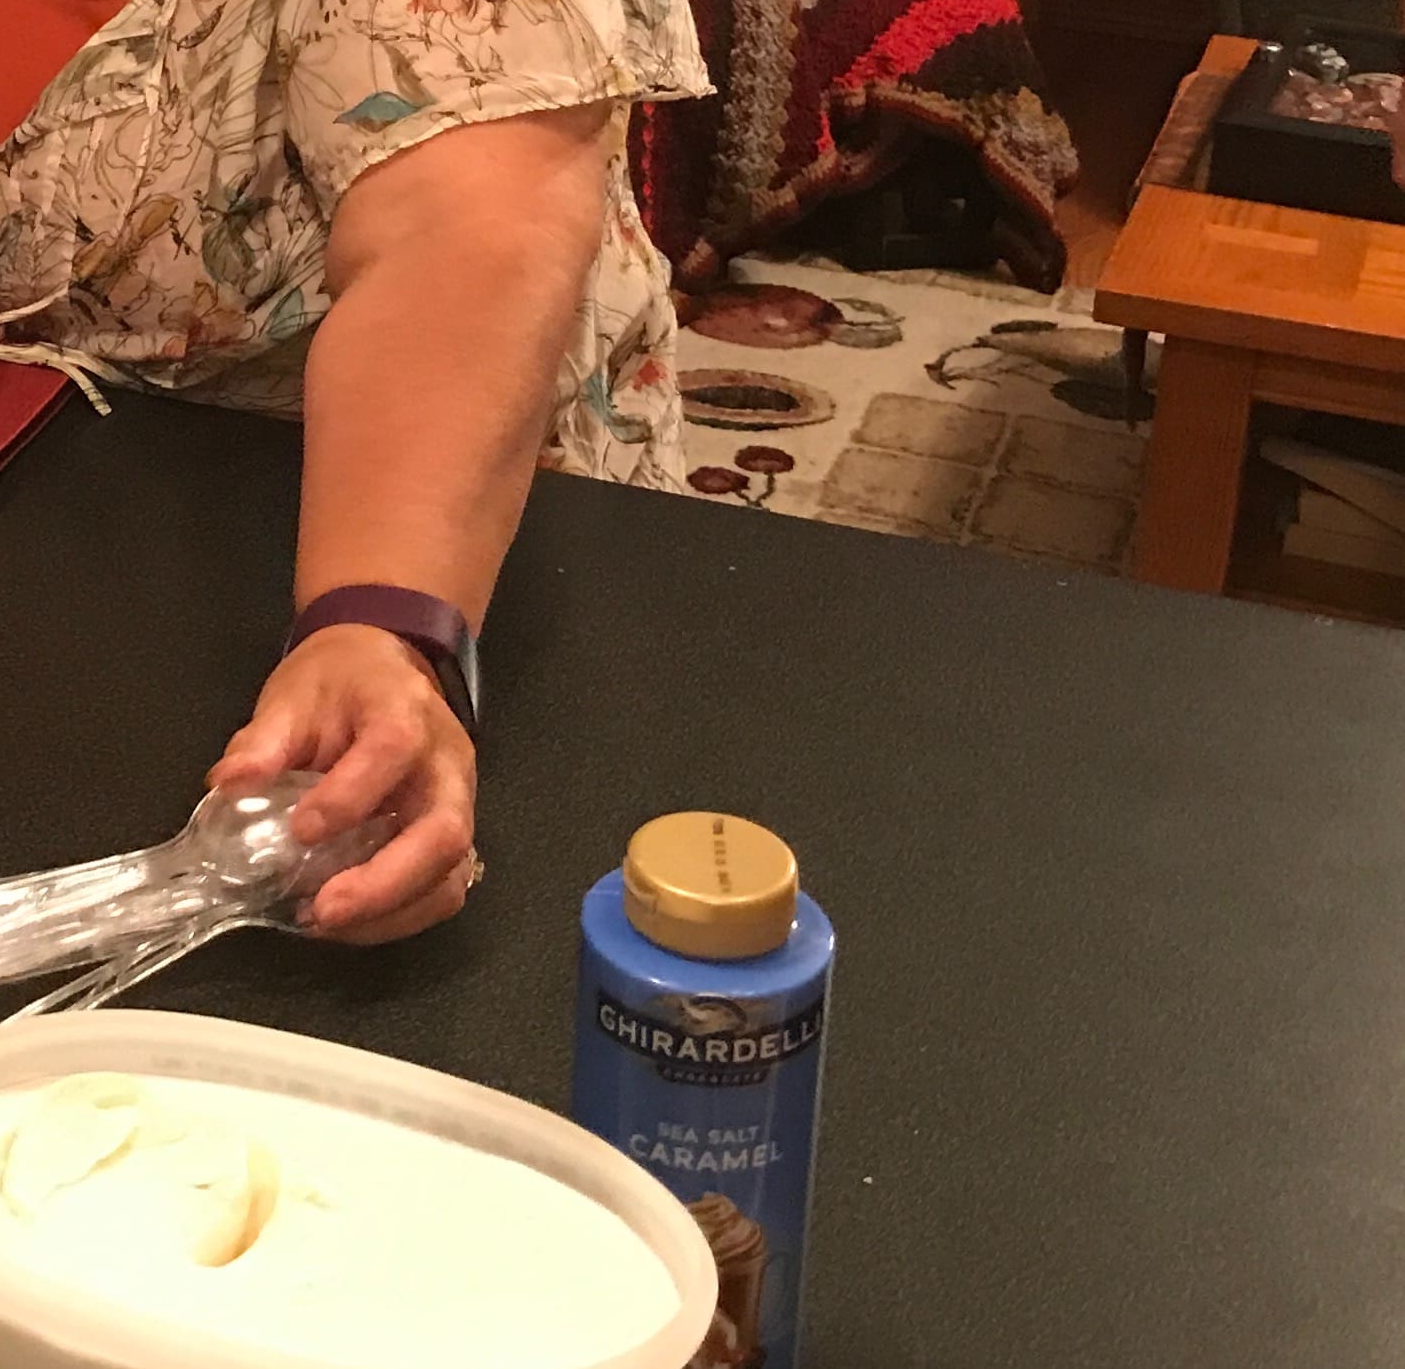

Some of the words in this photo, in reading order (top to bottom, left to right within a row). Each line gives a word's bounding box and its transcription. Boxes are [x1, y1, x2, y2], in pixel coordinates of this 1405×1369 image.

[658, 1122, 699, 1143] SEA
[707, 1125, 759, 1145] SALT
[629, 1133, 783, 1173] CARAMEL
